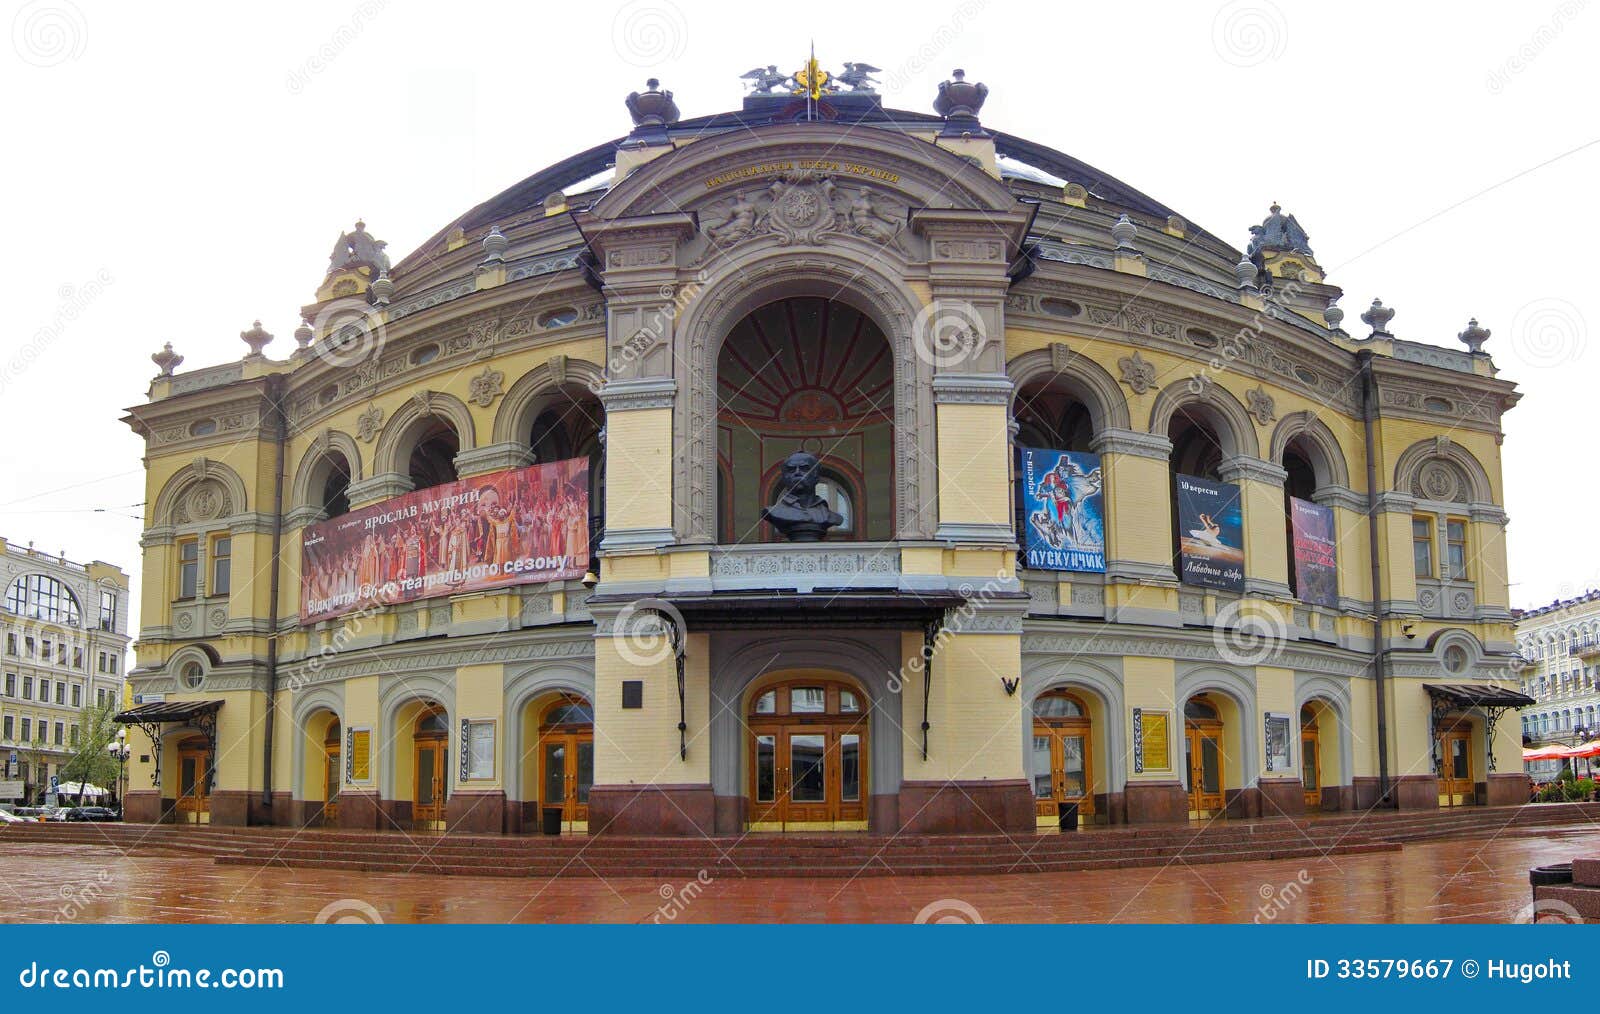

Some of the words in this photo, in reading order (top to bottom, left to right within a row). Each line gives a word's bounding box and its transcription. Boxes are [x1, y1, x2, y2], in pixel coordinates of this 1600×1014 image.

[364, 504, 418, 530] ЯРОСЛАВ
[421, 487, 481, 514] МУДРИЙ
[400, 564, 500, 591] театрального
[503, 554, 569, 574] сезону
[1030, 549, 1104, 569] ЛУСКУНЧИК
